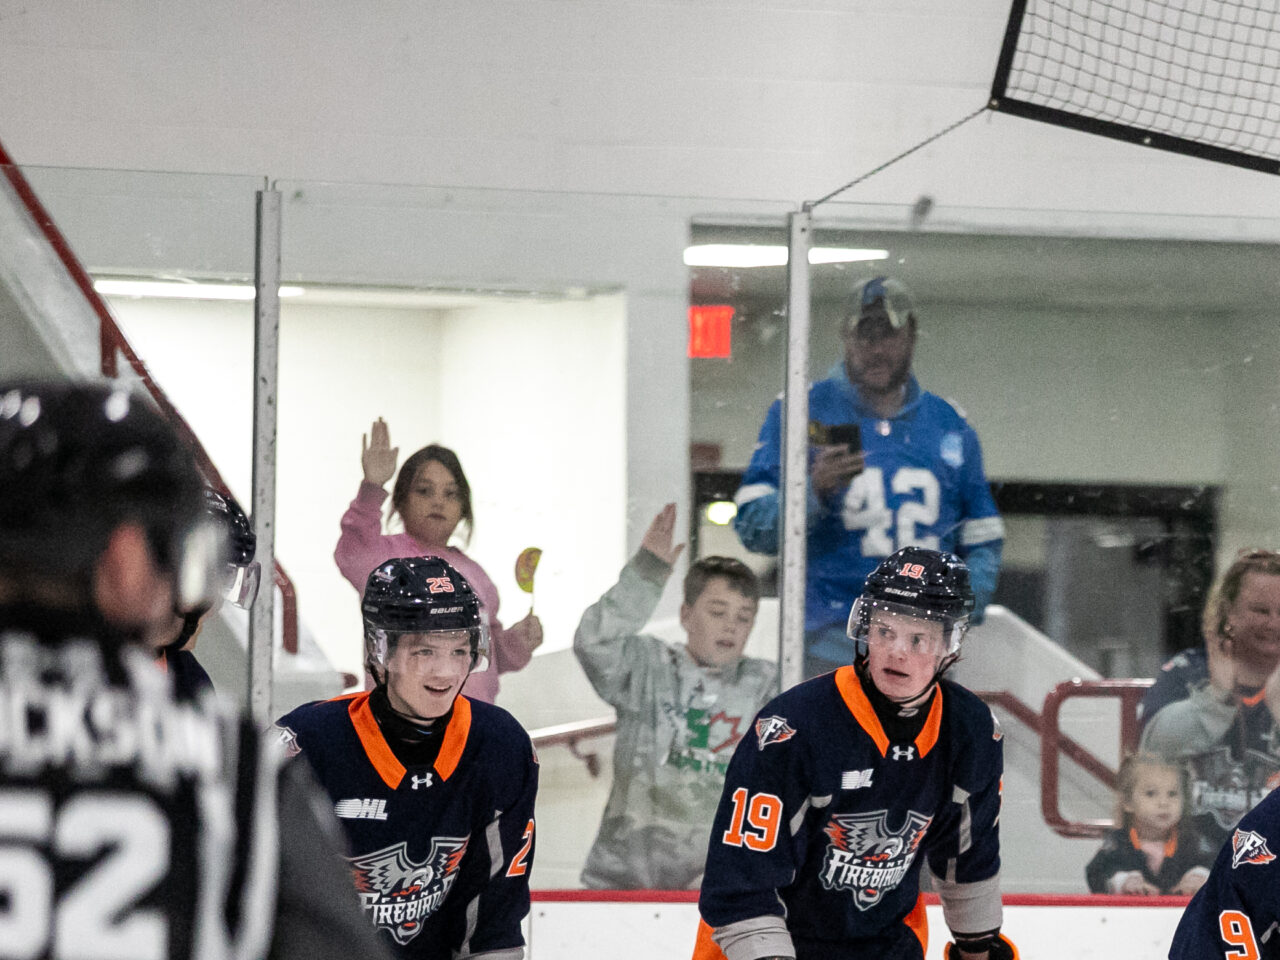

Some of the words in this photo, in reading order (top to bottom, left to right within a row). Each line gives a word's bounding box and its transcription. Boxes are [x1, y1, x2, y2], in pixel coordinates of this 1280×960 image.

[842, 466, 941, 557] 42
[426, 576, 455, 594] 25
[900, 562, 925, 580] 19
[505, 818, 536, 878] 2
[722, 787, 783, 851] 19
